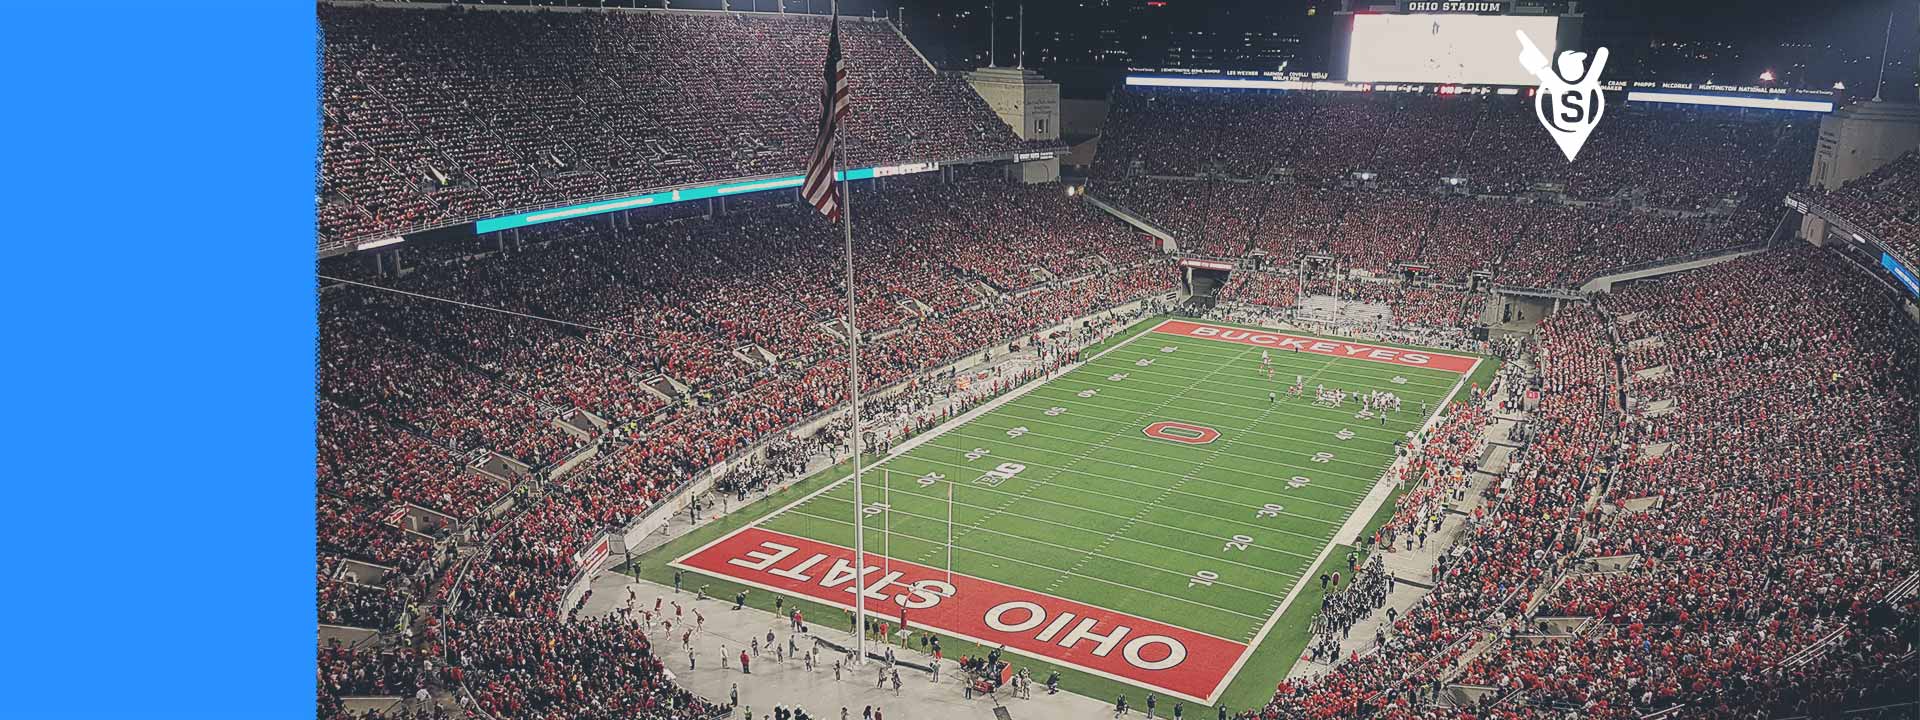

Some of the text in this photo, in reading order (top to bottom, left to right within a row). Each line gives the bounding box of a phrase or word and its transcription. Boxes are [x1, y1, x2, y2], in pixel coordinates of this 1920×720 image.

[1409, 2, 1500, 11] OHIO STADIUM
[1698, 84, 1737, 92] HUNTINGTON
[1191, 327, 1430, 365] BUCKEYES
[1141, 421, 1222, 445] O
[965, 447, 990, 460] 30
[1311, 452, 1335, 464] 50
[917, 471, 946, 485] 20
[1287, 476, 1311, 489] 40
[862, 501, 892, 515] 10
[1259, 503, 1285, 519] 30
[1227, 534, 1254, 551] 20
[1191, 570, 1219, 586] 10
[727, 541, 1189, 671] OHIO STATE
